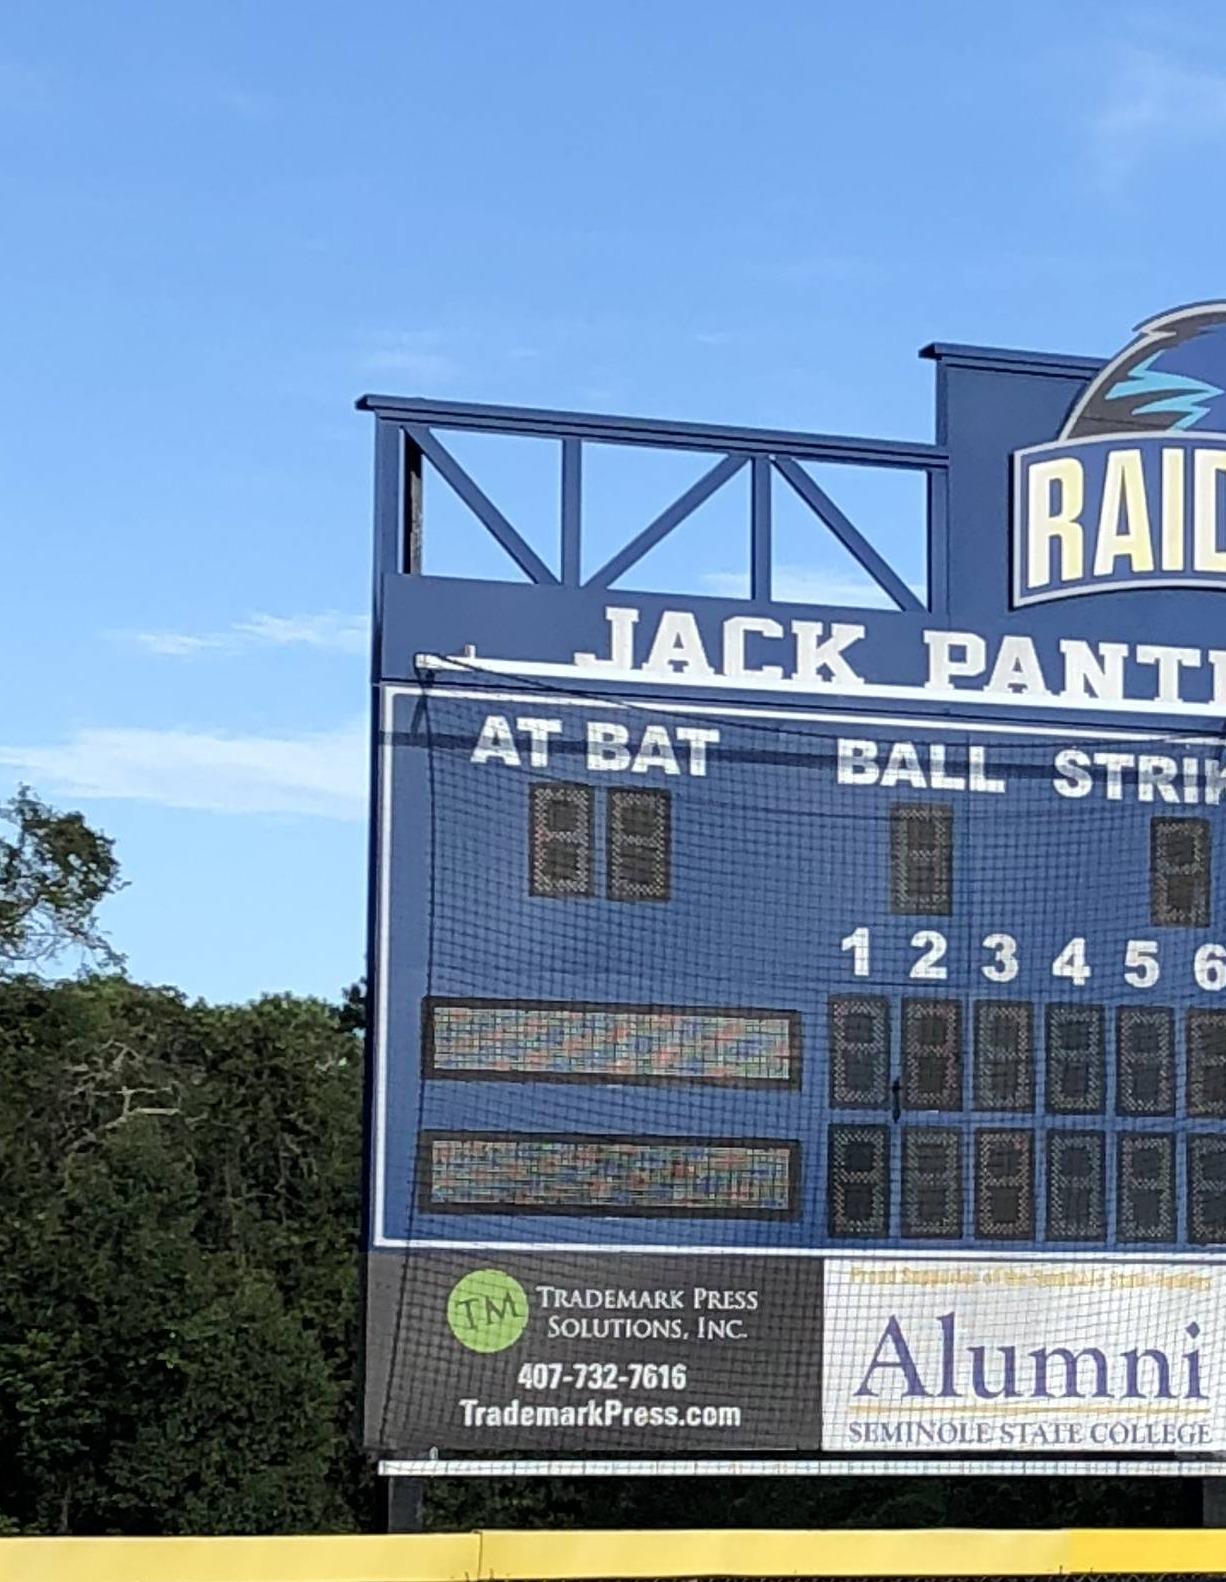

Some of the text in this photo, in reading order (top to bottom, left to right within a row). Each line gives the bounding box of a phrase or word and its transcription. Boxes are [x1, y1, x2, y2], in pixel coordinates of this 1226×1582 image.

[573, 606, 864, 685] JACK
[470, 715, 720, 776] AT BAT
[836, 738, 1006, 793] BALL
[841, 927, 870, 977] 1
[909, 930, 948, 980] 2
[981, 933, 1020, 982] 3
[1051, 937, 1092, 986] 4
[1123, 940, 1160, 989] 5
[454, 1292, 524, 1330] TM
[517, 1363, 687, 1391] 407-732-7616
[852, 1311, 1210, 1400] Alumni
[458, 1400, 742, 1428] TrademarkPress.com
[848, 1421, 1212, 1445] SEMINOLE STATE COLLEGE
